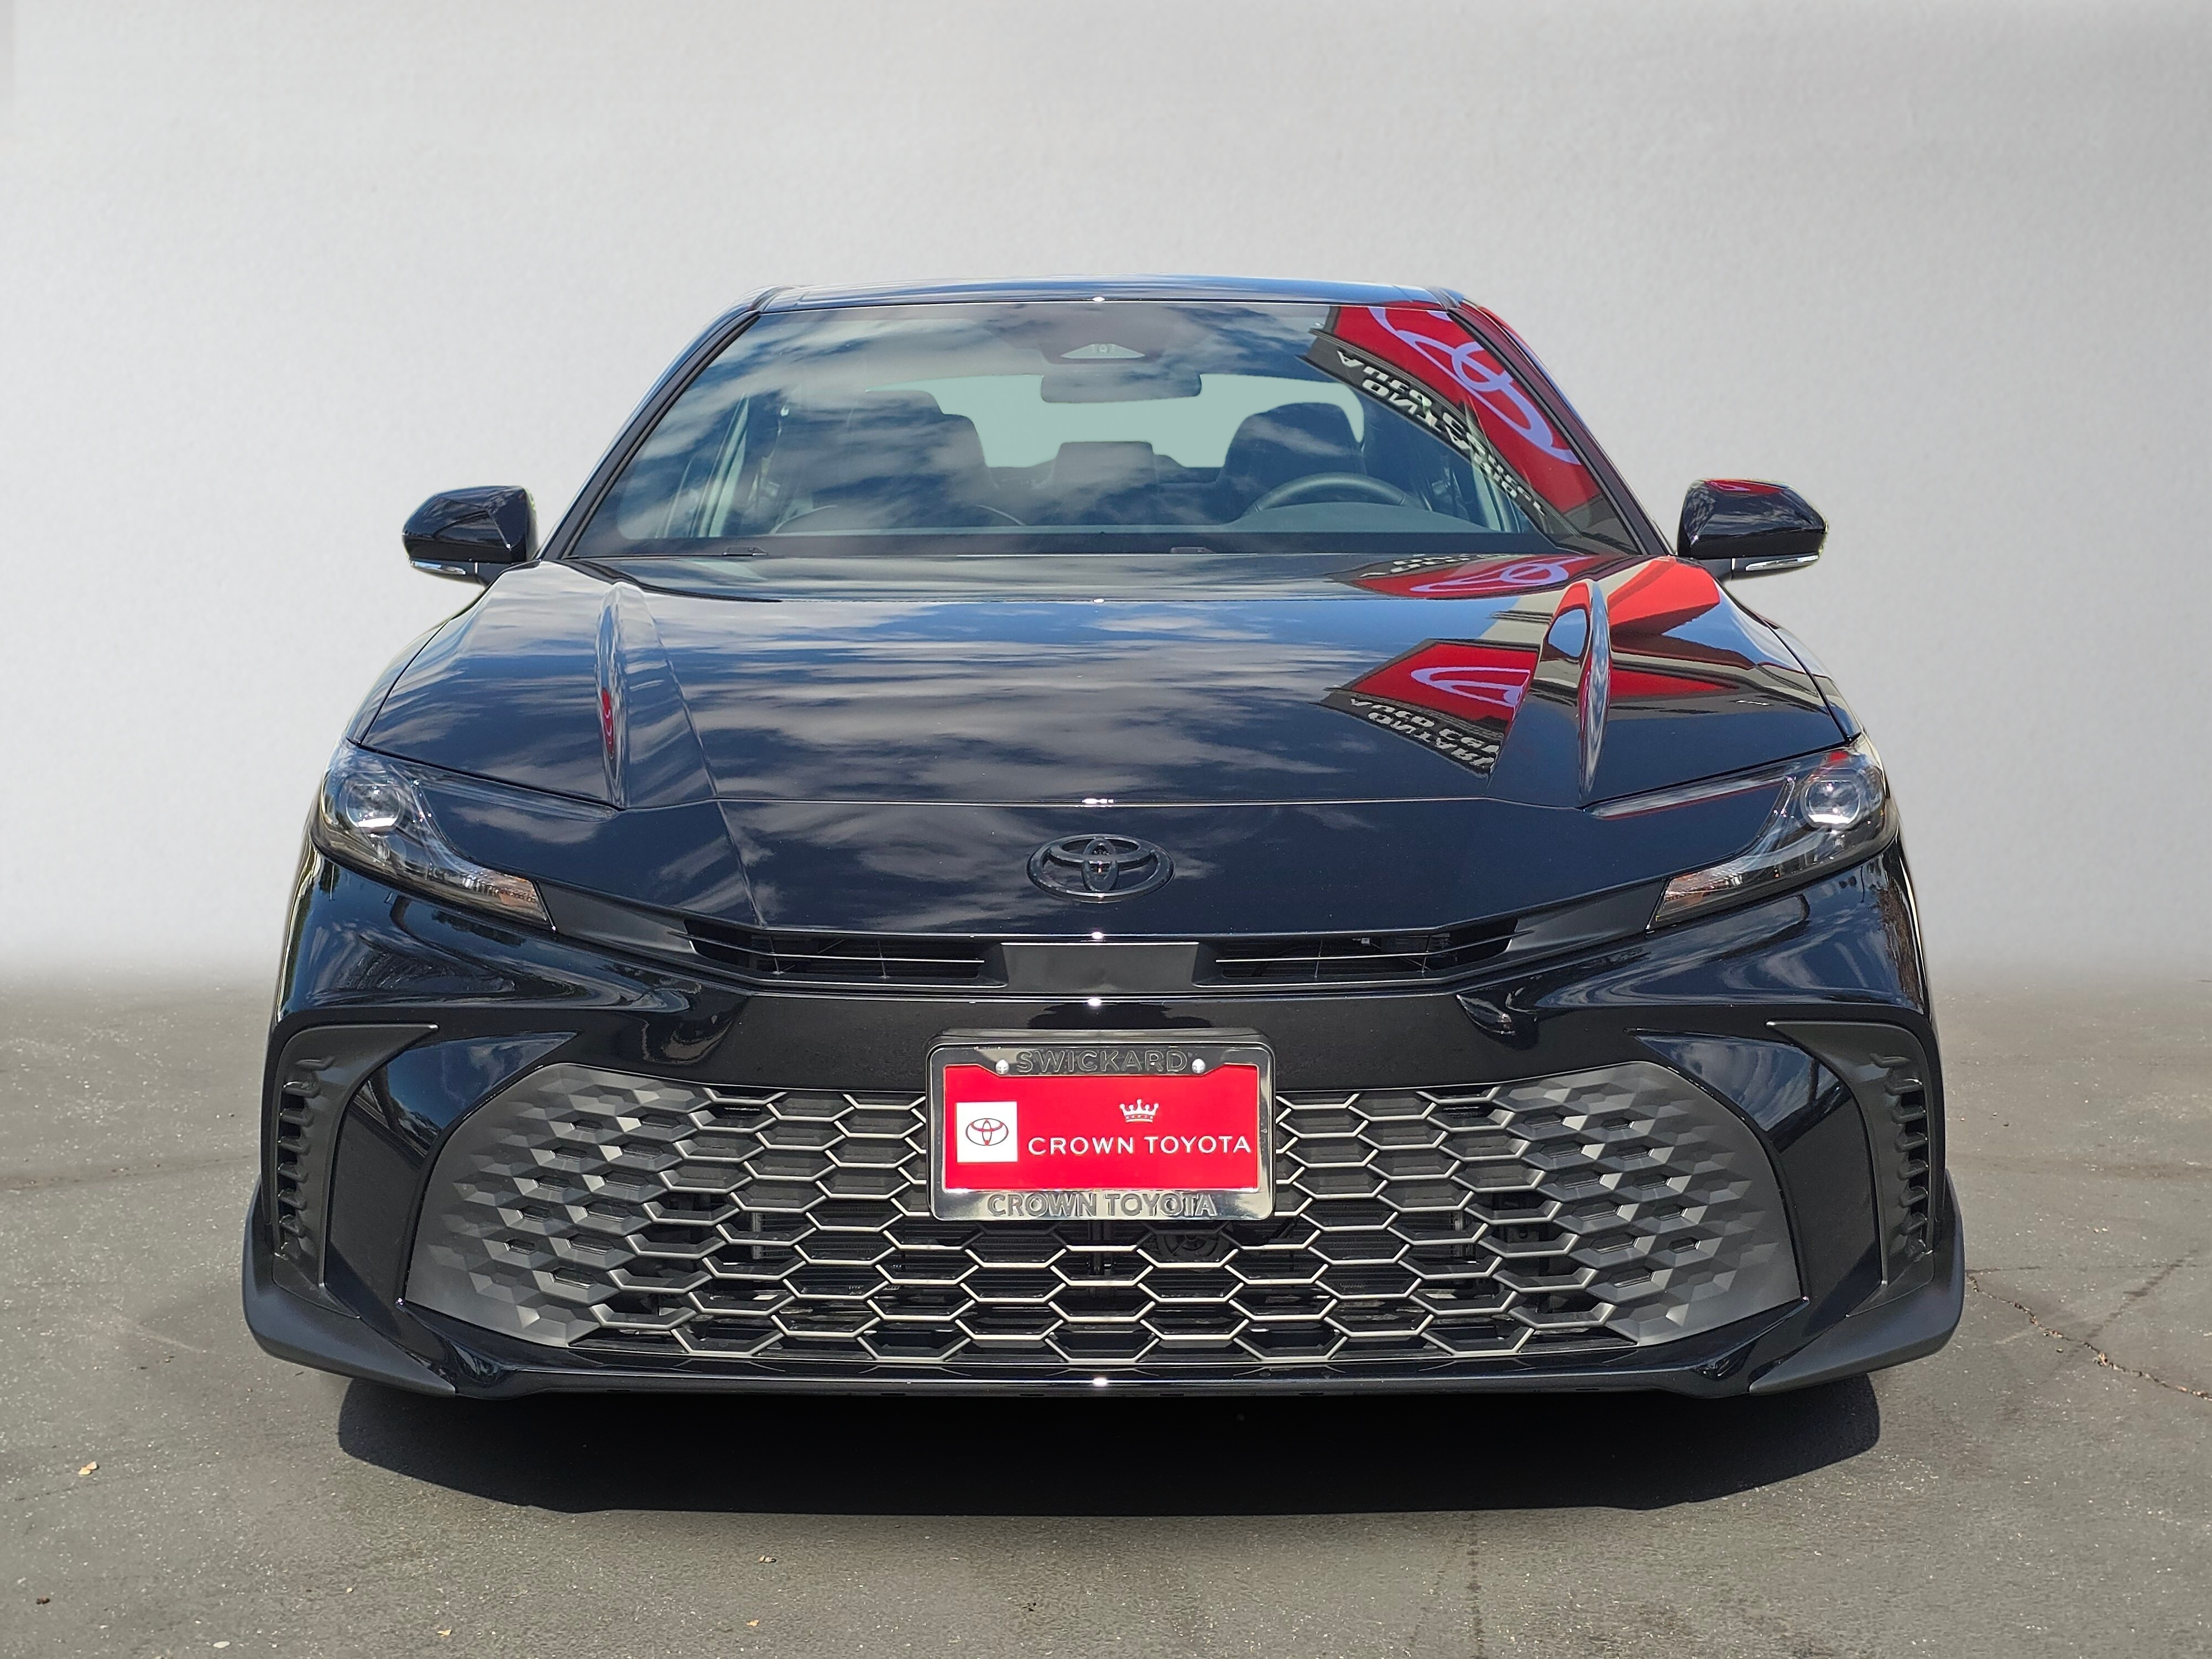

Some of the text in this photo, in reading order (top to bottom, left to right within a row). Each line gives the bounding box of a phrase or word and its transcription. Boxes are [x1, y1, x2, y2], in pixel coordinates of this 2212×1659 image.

[1016, 1050, 1187, 1073] SWICKARD
[1028, 1135, 1251, 1156] CROWN TOYOTA
[987, 1193, 1217, 1217] CROWN TOYOTA
